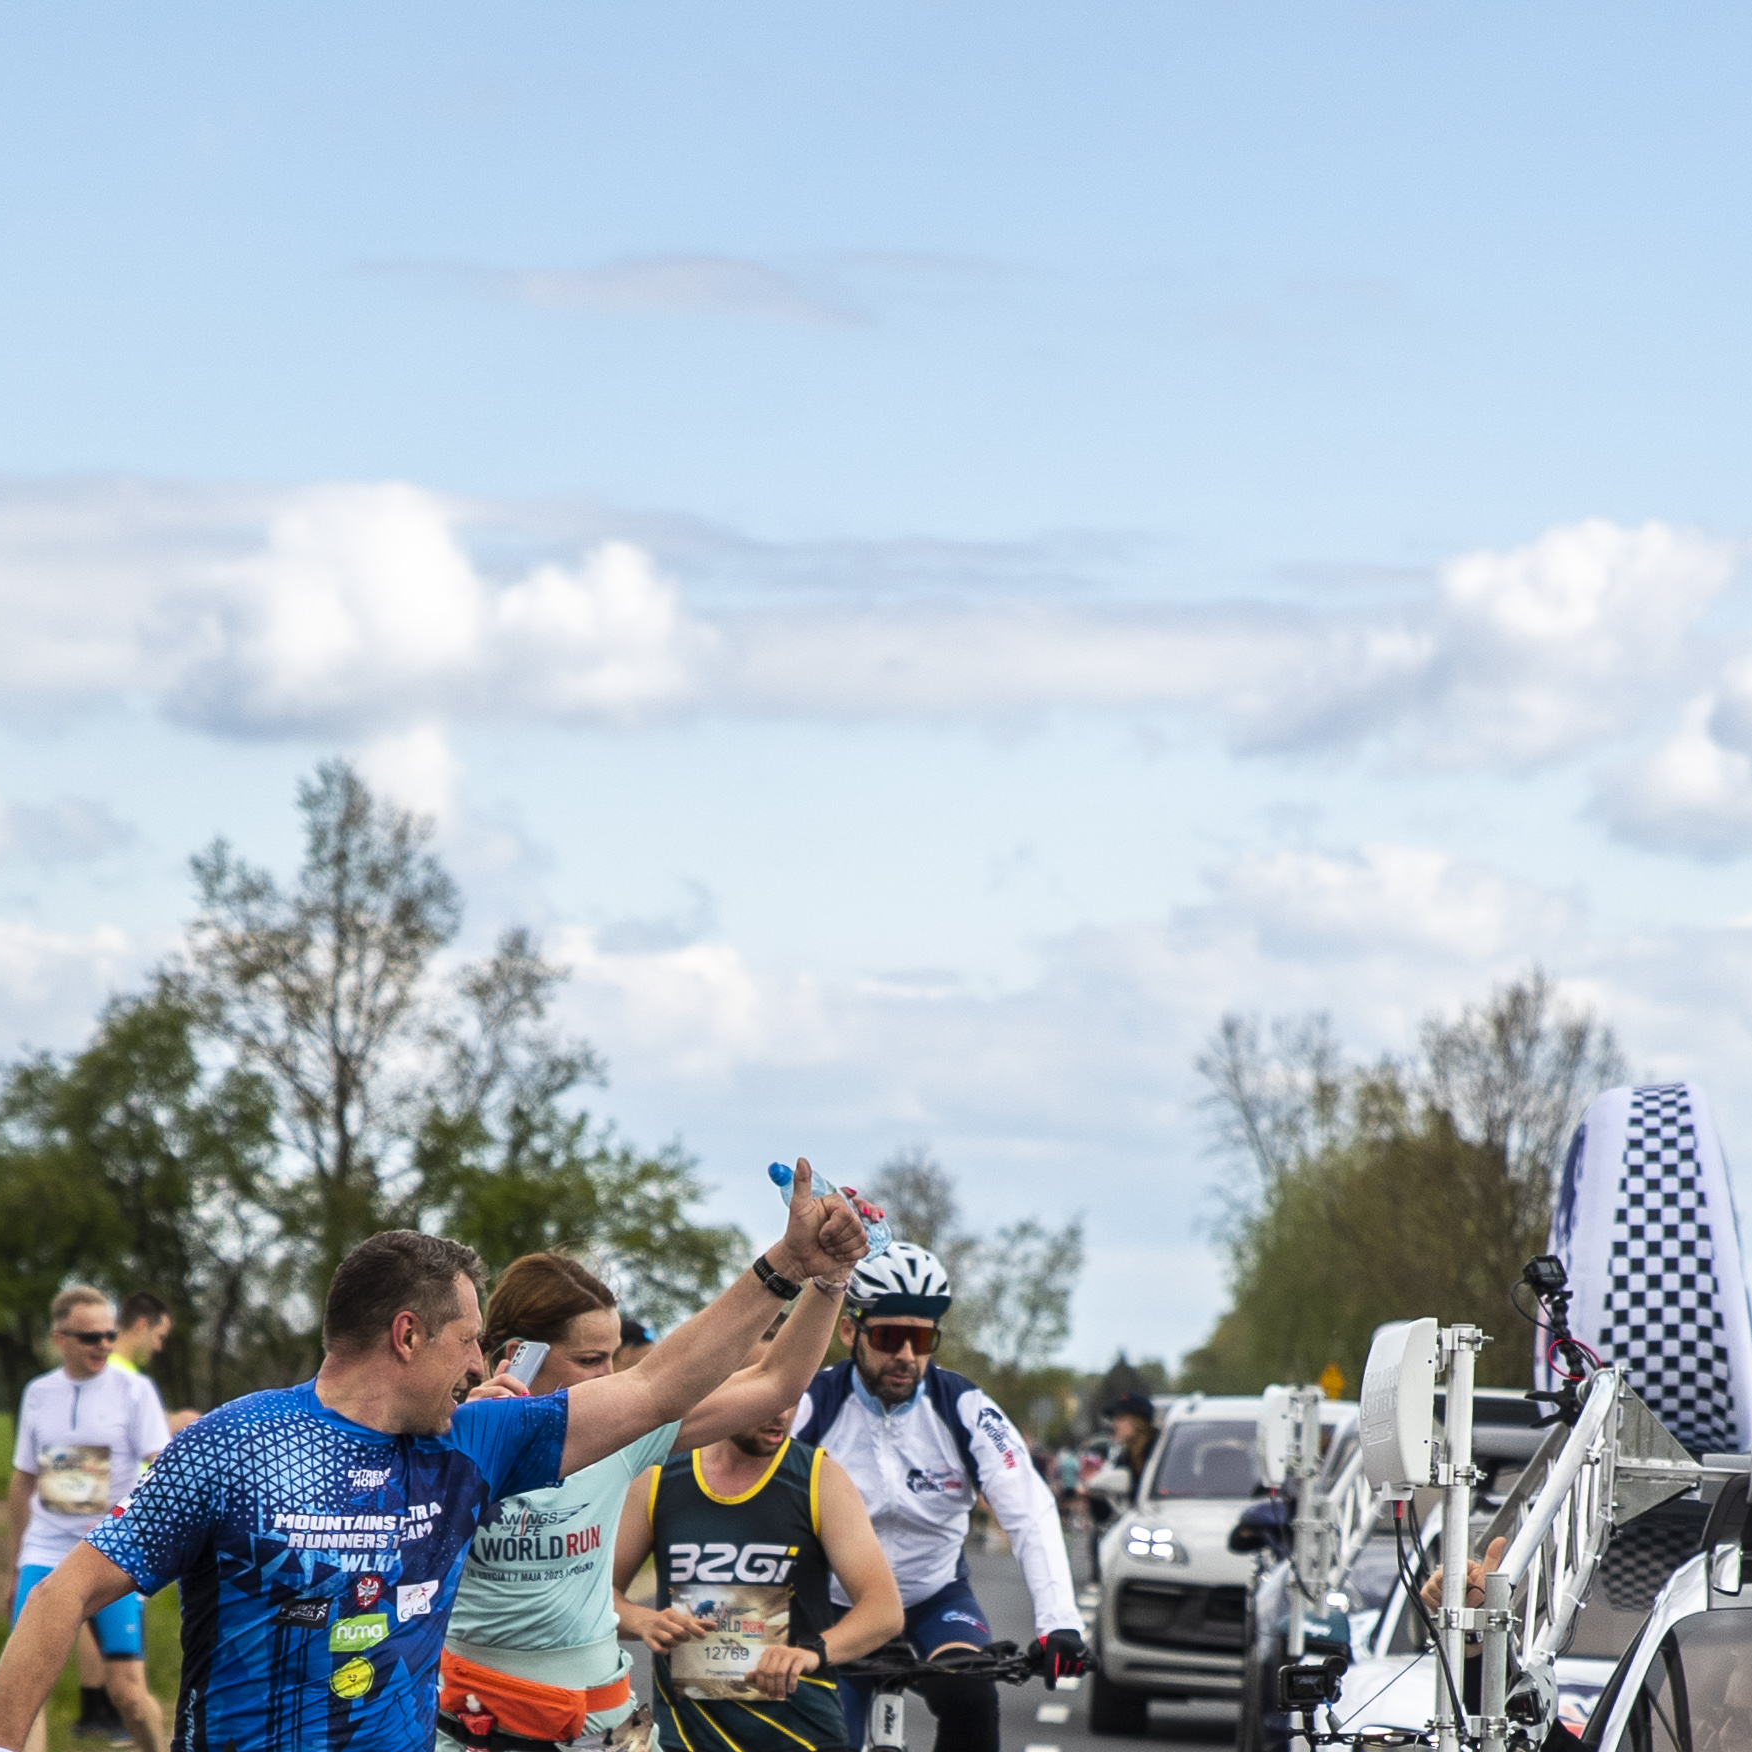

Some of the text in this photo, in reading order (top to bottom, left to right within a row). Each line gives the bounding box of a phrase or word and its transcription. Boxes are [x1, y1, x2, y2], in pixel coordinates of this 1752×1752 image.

[274, 1514, 397, 1531] MOUNTAINS
[504, 1511, 558, 1525] WINGS
[511, 1525, 543, 1537] LIFE
[288, 1533, 388, 1549] RUNNERS
[481, 1525, 601, 1561] WORLD RUN
[520, 1571, 542, 1582] MAJA
[543, 1570, 564, 1581] 2023
[704, 1646, 750, 1661] 12769
